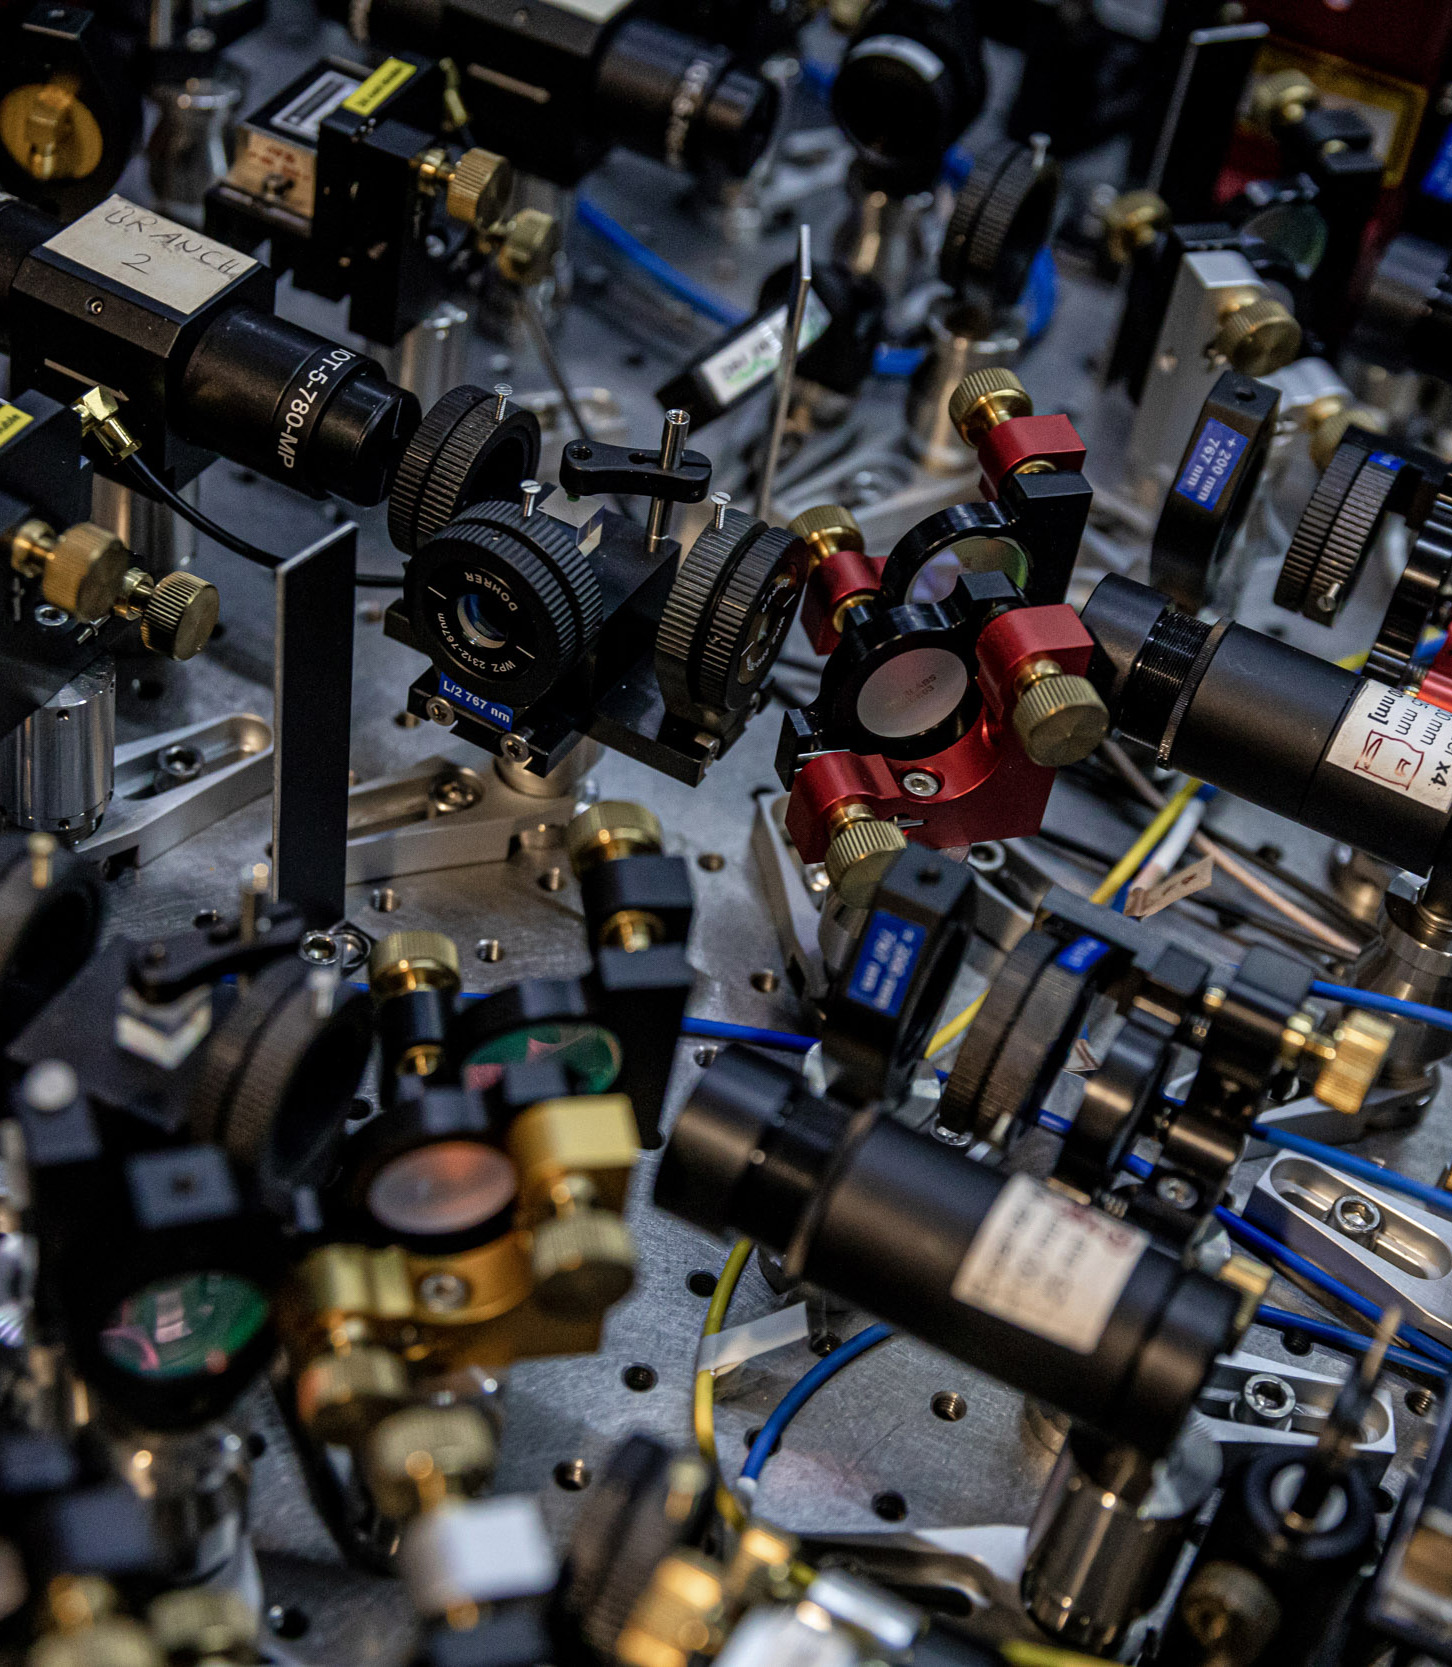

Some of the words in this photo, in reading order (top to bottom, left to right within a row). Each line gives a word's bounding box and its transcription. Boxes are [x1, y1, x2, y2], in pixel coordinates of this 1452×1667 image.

[105, 206, 240, 274] BRANCH
[121, 253, 151, 275] 2
[277, 348, 357, 469] IOT-5-780-MP
[1201, 438, 1220, 465] 767
[1211, 449, 1232, 475] 200
[443, 680, 463, 698] L/2
[465, 691, 488, 710] 767
[490, 707, 510, 723] nm
[1367, 695, 1396, 725] nm]
[1395, 708, 1418, 736] mm
[1420, 719, 1443, 746] mm
